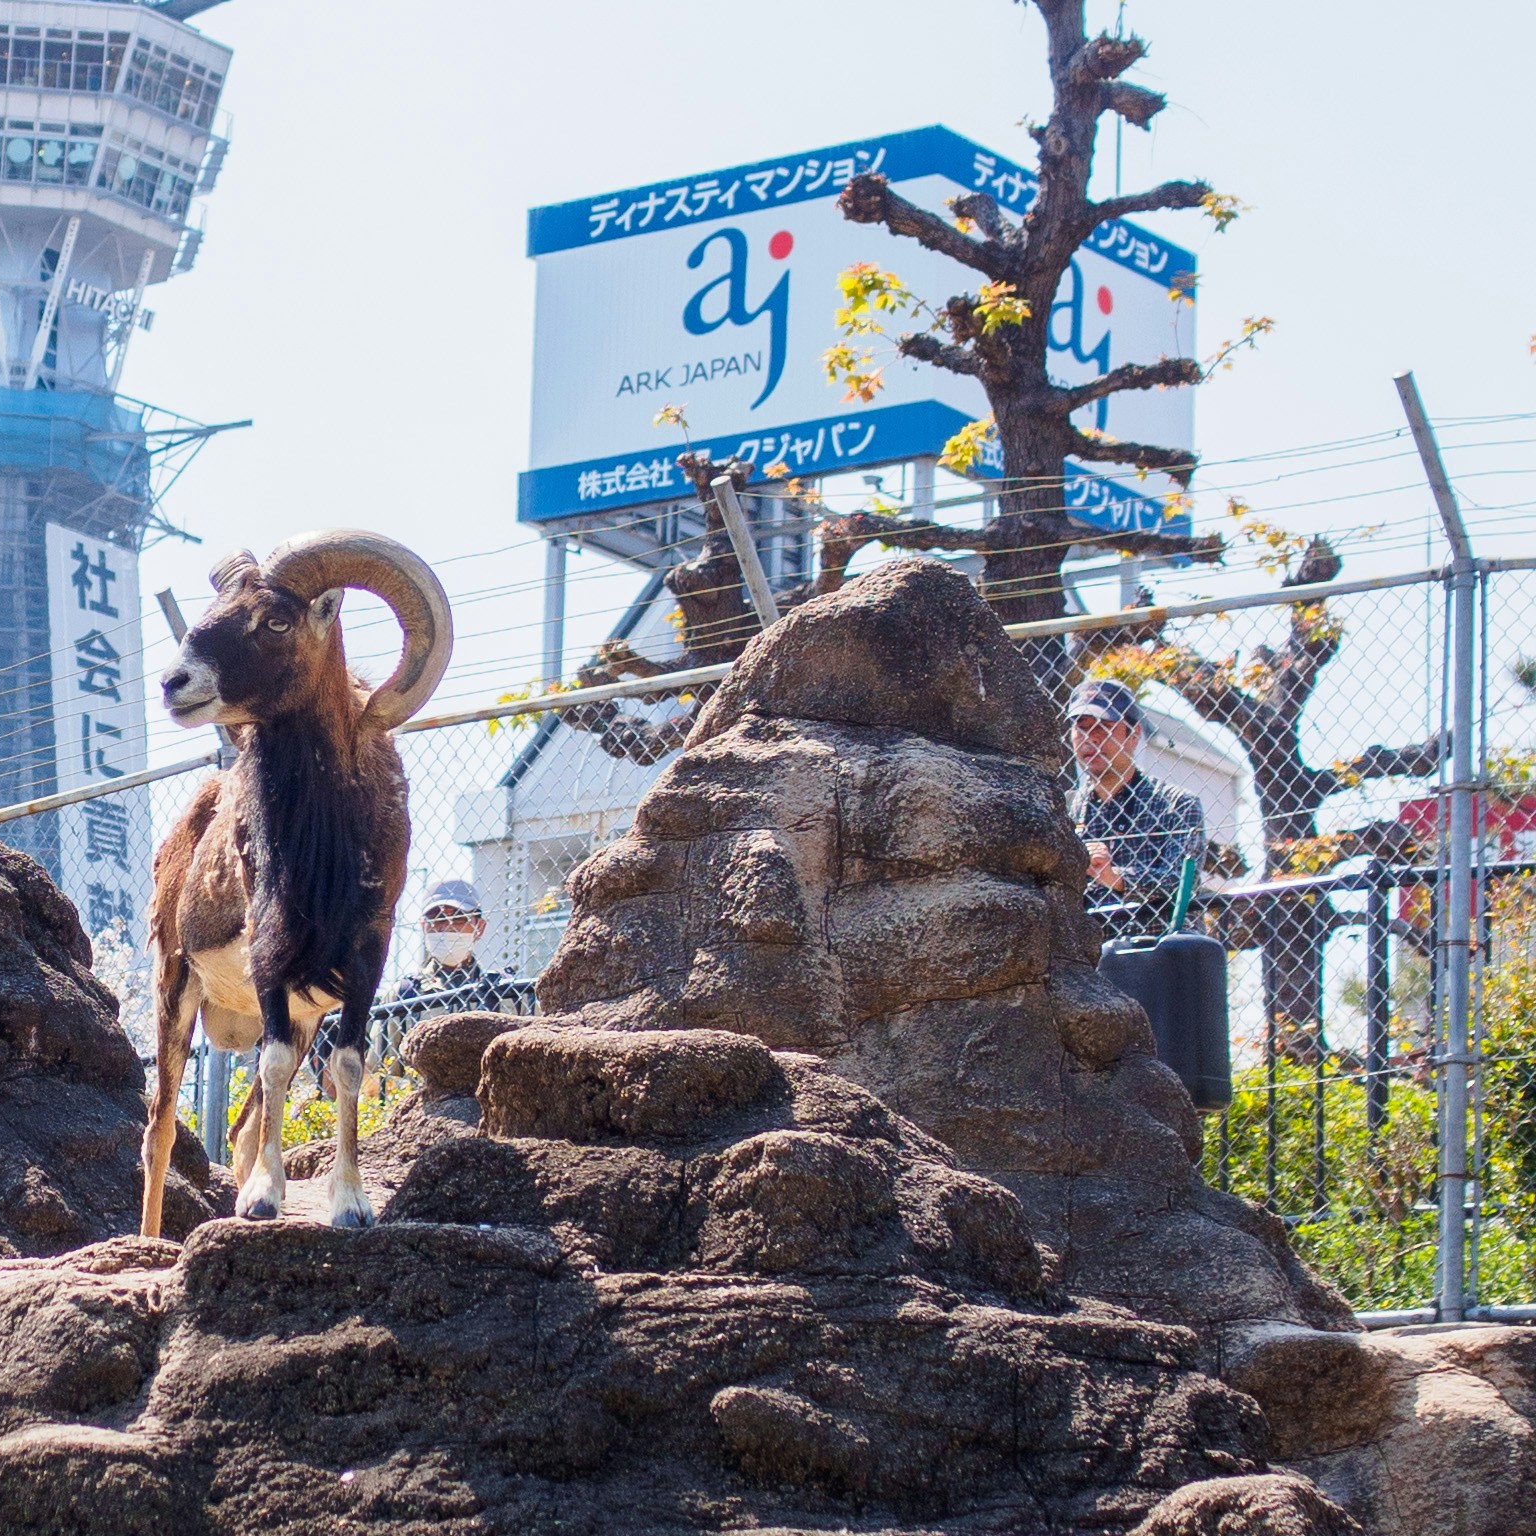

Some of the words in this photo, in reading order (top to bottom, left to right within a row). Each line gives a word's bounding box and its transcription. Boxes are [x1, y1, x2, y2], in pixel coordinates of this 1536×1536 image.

[589, 148, 886, 238] ディナスティマンション
[616, 367, 672, 398] ARK
[679, 350, 762, 387] JAPAN
